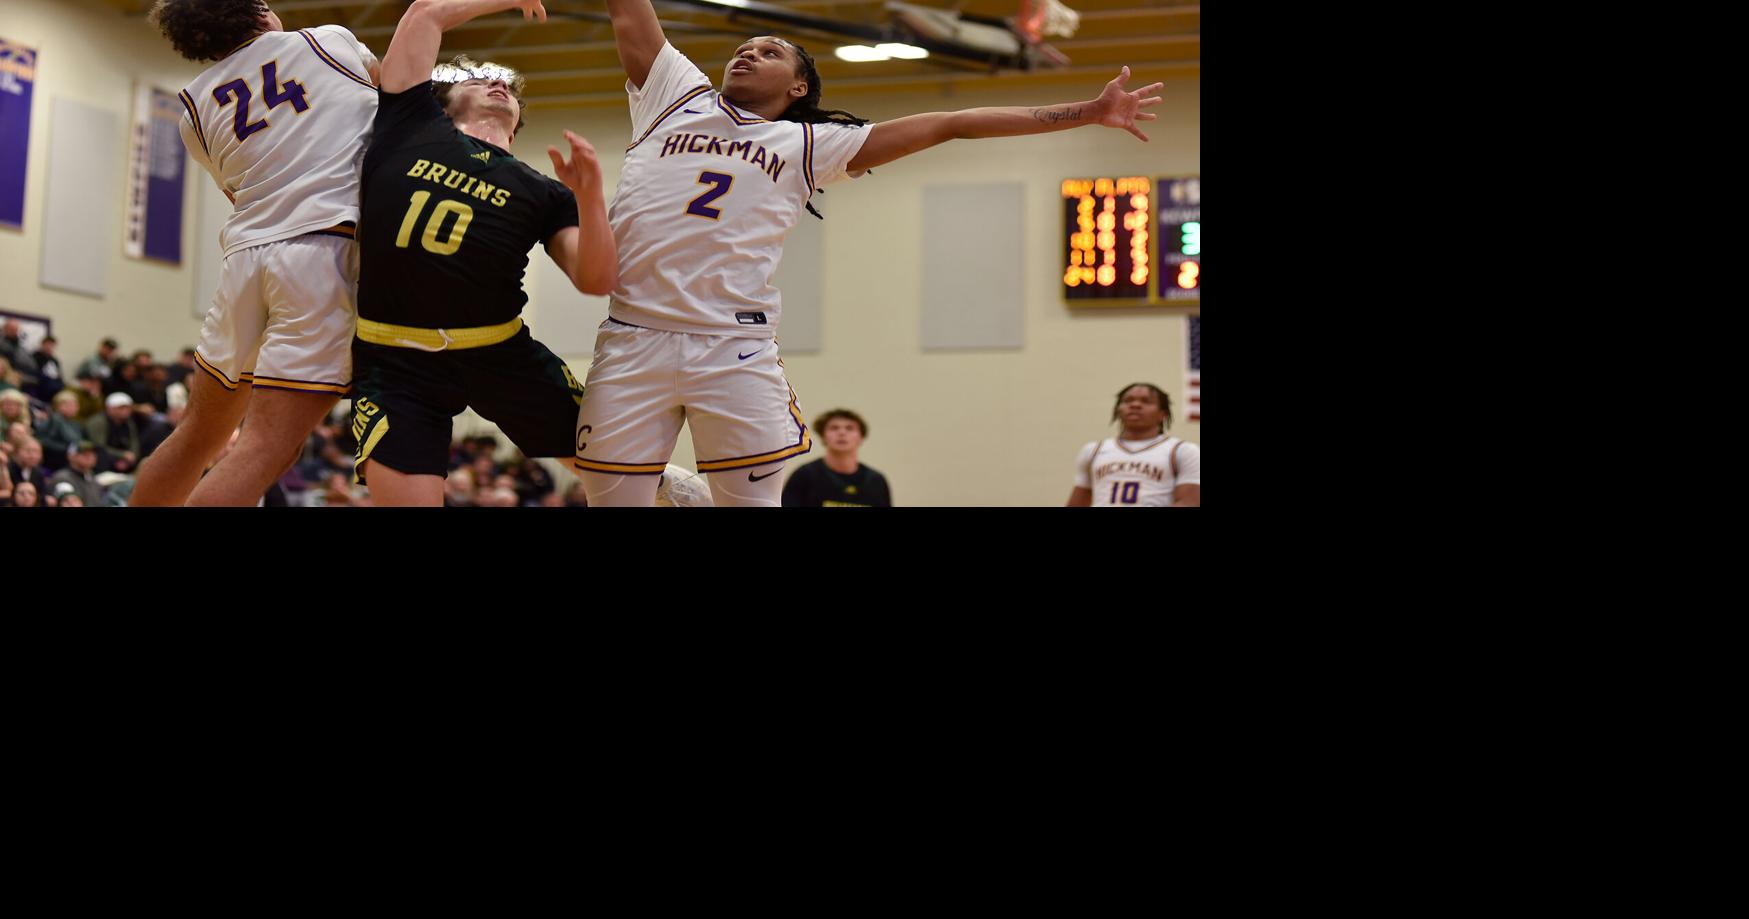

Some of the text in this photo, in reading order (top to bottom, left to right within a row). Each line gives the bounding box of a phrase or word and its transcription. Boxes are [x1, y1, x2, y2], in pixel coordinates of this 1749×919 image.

[211, 59, 312, 144] 24
[406, 158, 511, 207] BRUINS
[659, 132, 787, 184] HICKMAN
[683, 168, 736, 221] 2
[395, 190, 474, 256] 10
[1095, 461, 1165, 482] HICKMAN
[1109, 480, 1141, 505] 10
